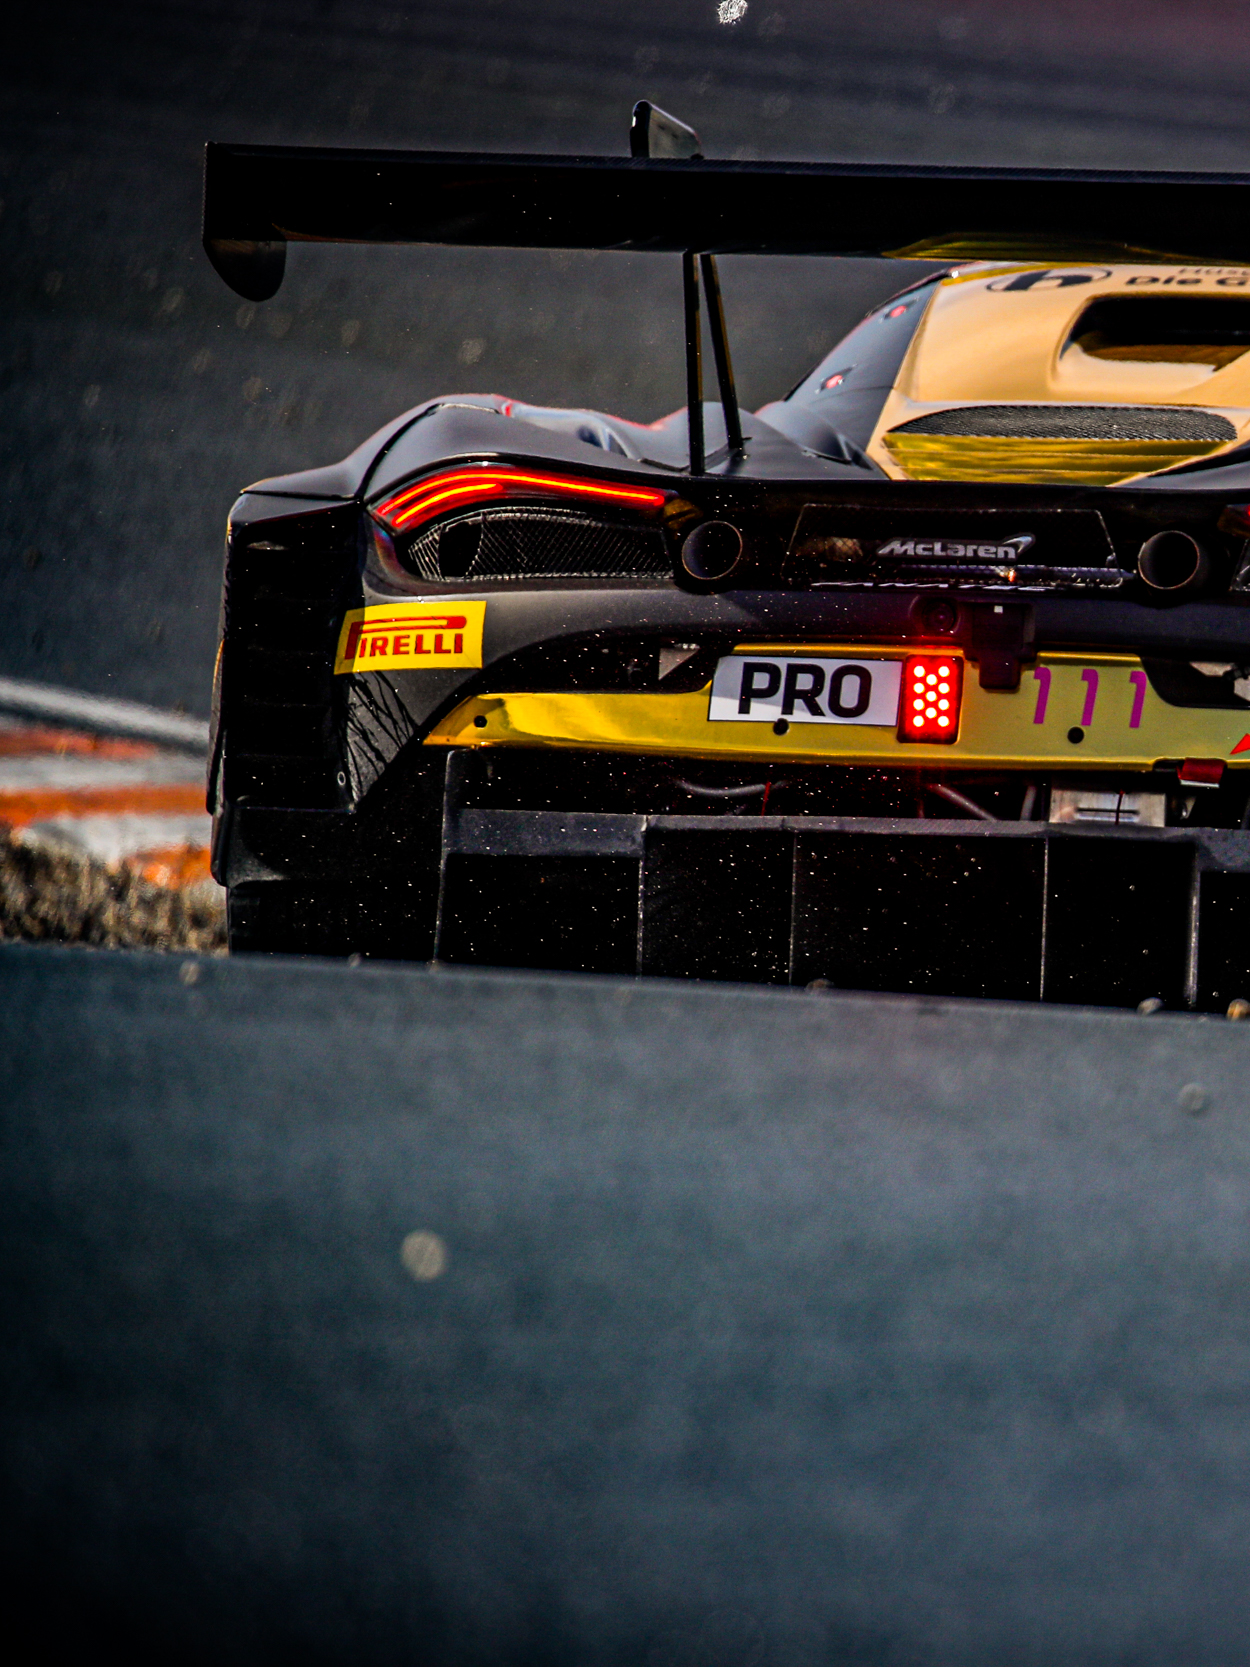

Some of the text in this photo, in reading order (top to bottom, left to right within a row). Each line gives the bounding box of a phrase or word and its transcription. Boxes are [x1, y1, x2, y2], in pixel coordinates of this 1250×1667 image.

[1125, 275, 1202, 285] Die
[877, 540, 1017, 560] McLaren
[344, 615, 467, 660] PIRELLI
[737, 661, 873, 718] PRO
[1032, 666, 1147, 728] 111
